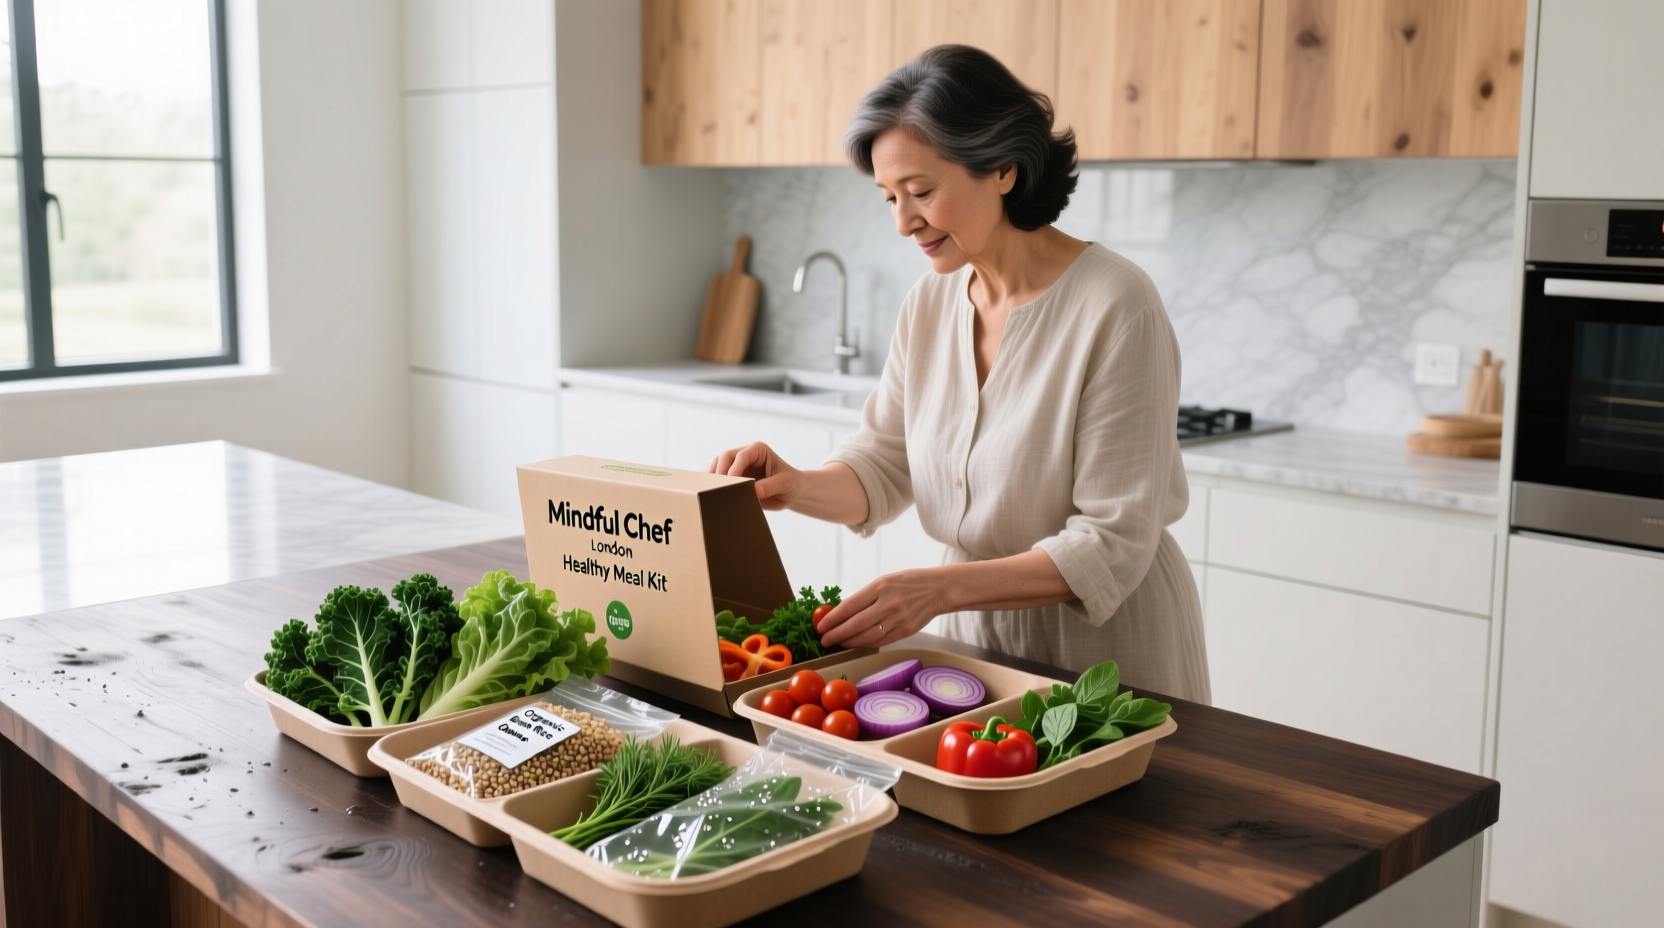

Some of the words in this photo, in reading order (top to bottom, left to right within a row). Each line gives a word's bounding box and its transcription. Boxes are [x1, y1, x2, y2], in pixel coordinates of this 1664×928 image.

[548, 499, 619, 535] Mindful
[623, 512, 673, 544] Chef
[591, 539, 633, 558] London
[563, 554, 610, 582] Healthy
[613, 565, 644, 587] Meal
[648, 571, 668, 592] Kit
